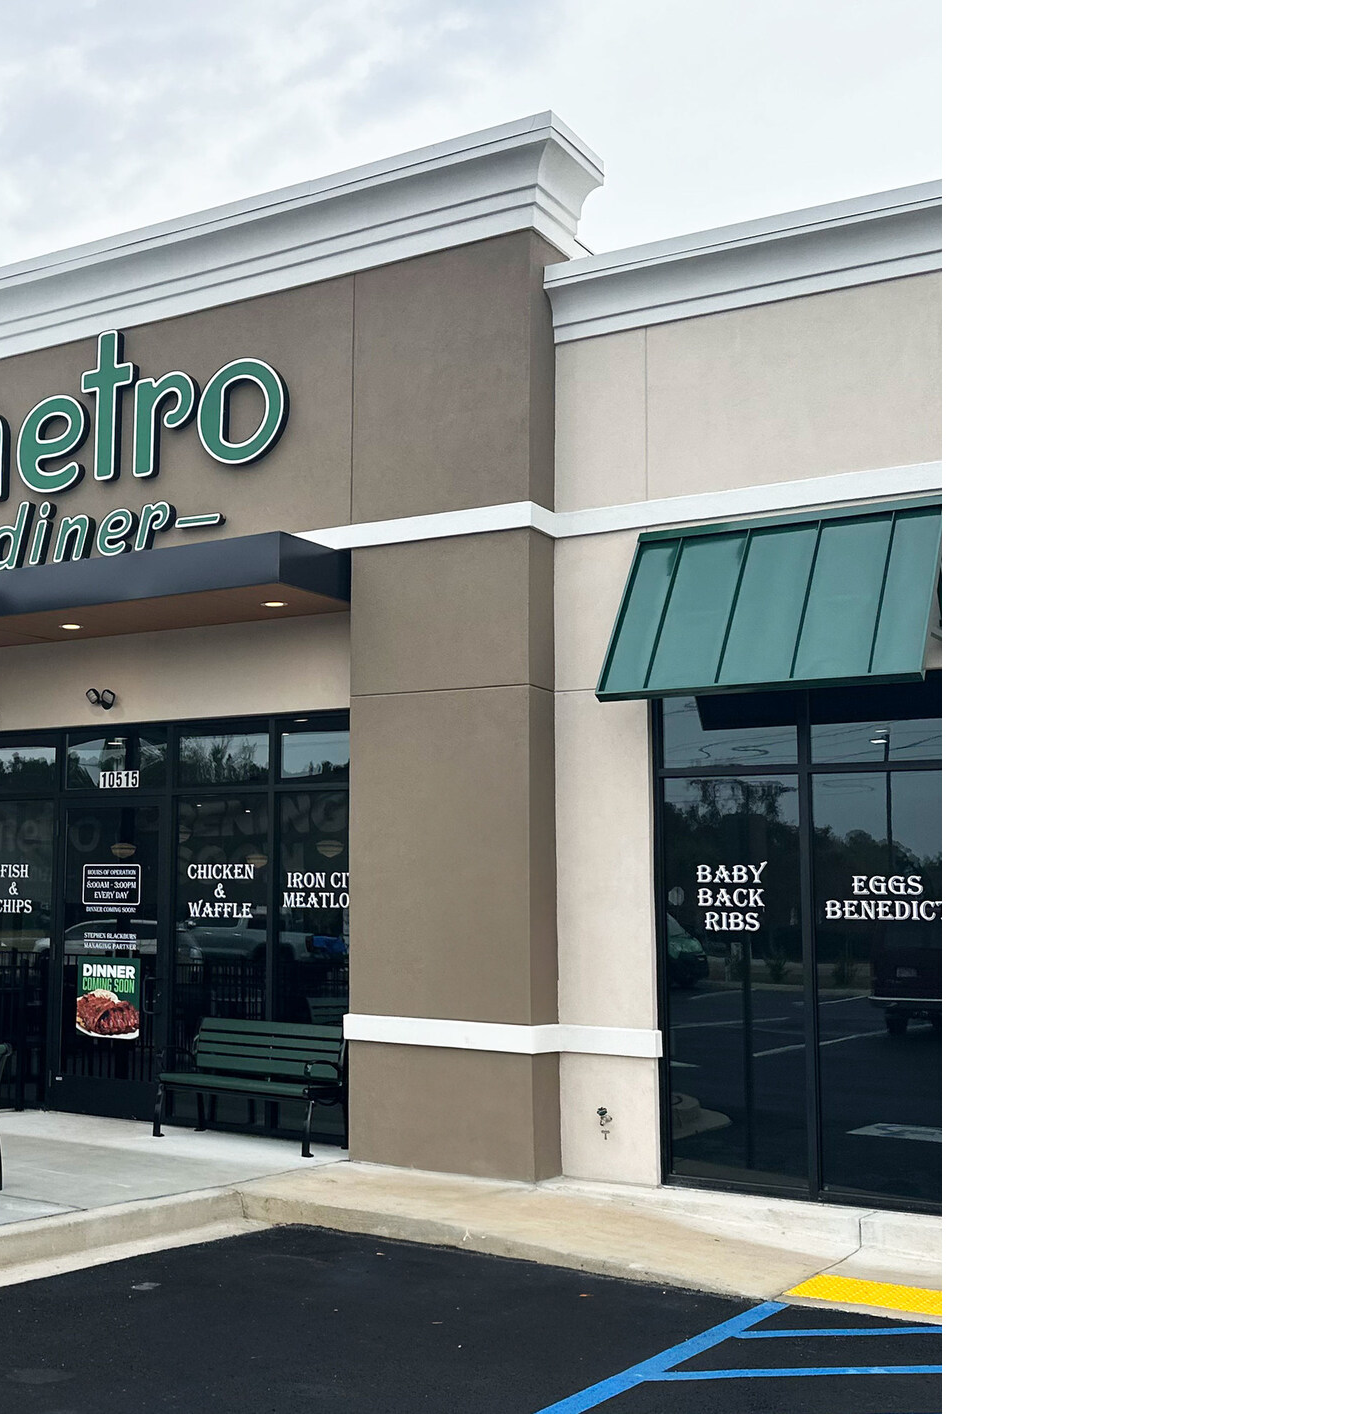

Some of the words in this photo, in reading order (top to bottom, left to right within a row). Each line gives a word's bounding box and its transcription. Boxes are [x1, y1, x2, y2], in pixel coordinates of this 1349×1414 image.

[101, 771, 138, 788] 10515
[0, 864, 29, 878] FISH
[187, 864, 255, 880] CHICKEN
[696, 861, 768, 884] BABY
[8, 881, 19, 895] &
[113, 881, 137, 889] 3:00PM
[287, 872, 326, 889] IRON
[330, 872, 350, 889] CI
[852, 875, 924, 895] EGGS
[94, 891, 115, 899] EVERY
[115, 891, 130, 899] DAY
[214, 883, 226, 898] &
[697, 888, 766, 907] BACK
[282, 892, 350, 908] MEATLO
[188, 899, 254, 918] WAFFLE
[704, 911, 761, 932] RIBS
[83, 963, 136, 979] DINNER
[82, 977, 112, 991] COMING
[114, 979, 135, 994] SOON
